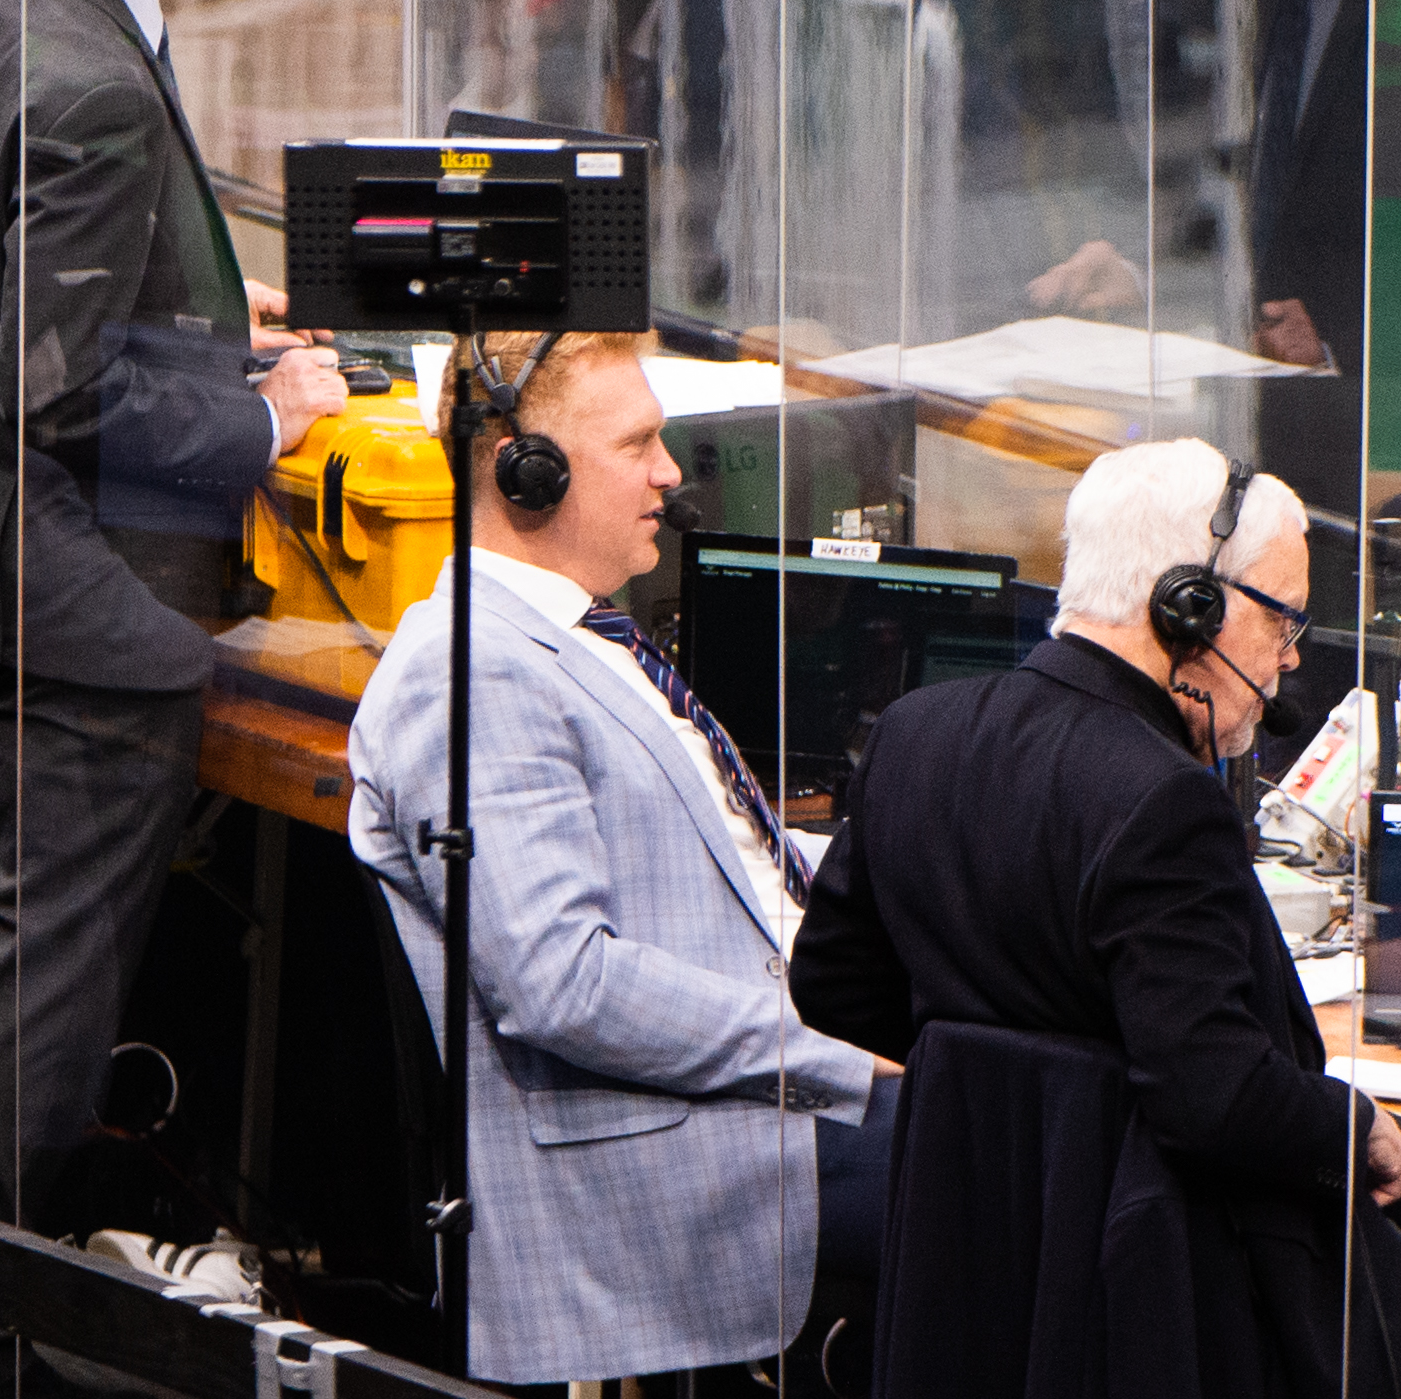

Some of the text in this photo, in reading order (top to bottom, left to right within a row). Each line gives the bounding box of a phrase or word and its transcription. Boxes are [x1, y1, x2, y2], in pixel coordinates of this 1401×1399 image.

[440, 148, 492, 169] ikan
[725, 445, 757, 473] LG
[820, 544, 872, 558] HAWKEYE
